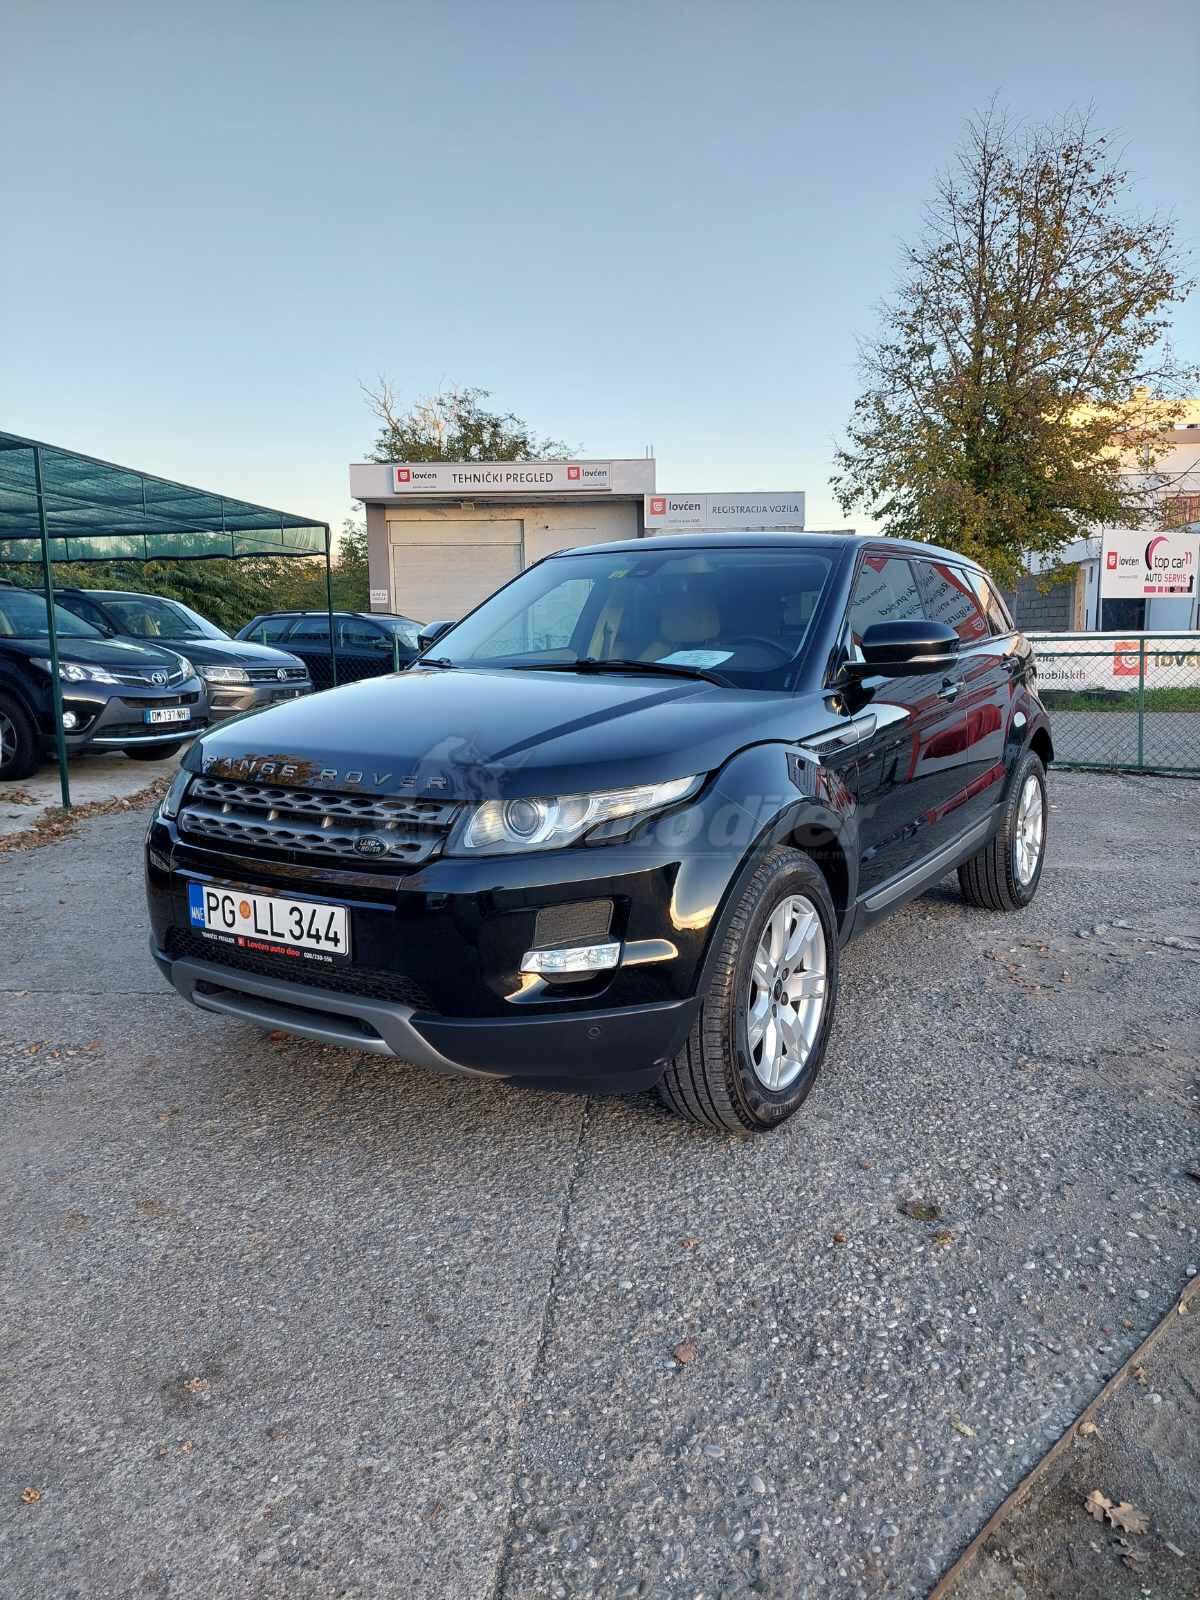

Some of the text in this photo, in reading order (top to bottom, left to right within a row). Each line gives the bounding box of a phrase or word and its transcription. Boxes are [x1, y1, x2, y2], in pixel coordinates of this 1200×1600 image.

[451, 471, 553, 483] TEHNIČKI PREGLED
[669, 501, 701, 511] lovćen
[712, 504, 800, 514] REGISTRACIJA VOZILA
[1154, 555, 1170, 571] top
[1145, 573, 1187, 583] AUTO SERVIS
[201, 755, 449, 790] RANGE ROVER
[206, 891, 237, 929] PG
[253, 899, 341, 948] LL344
